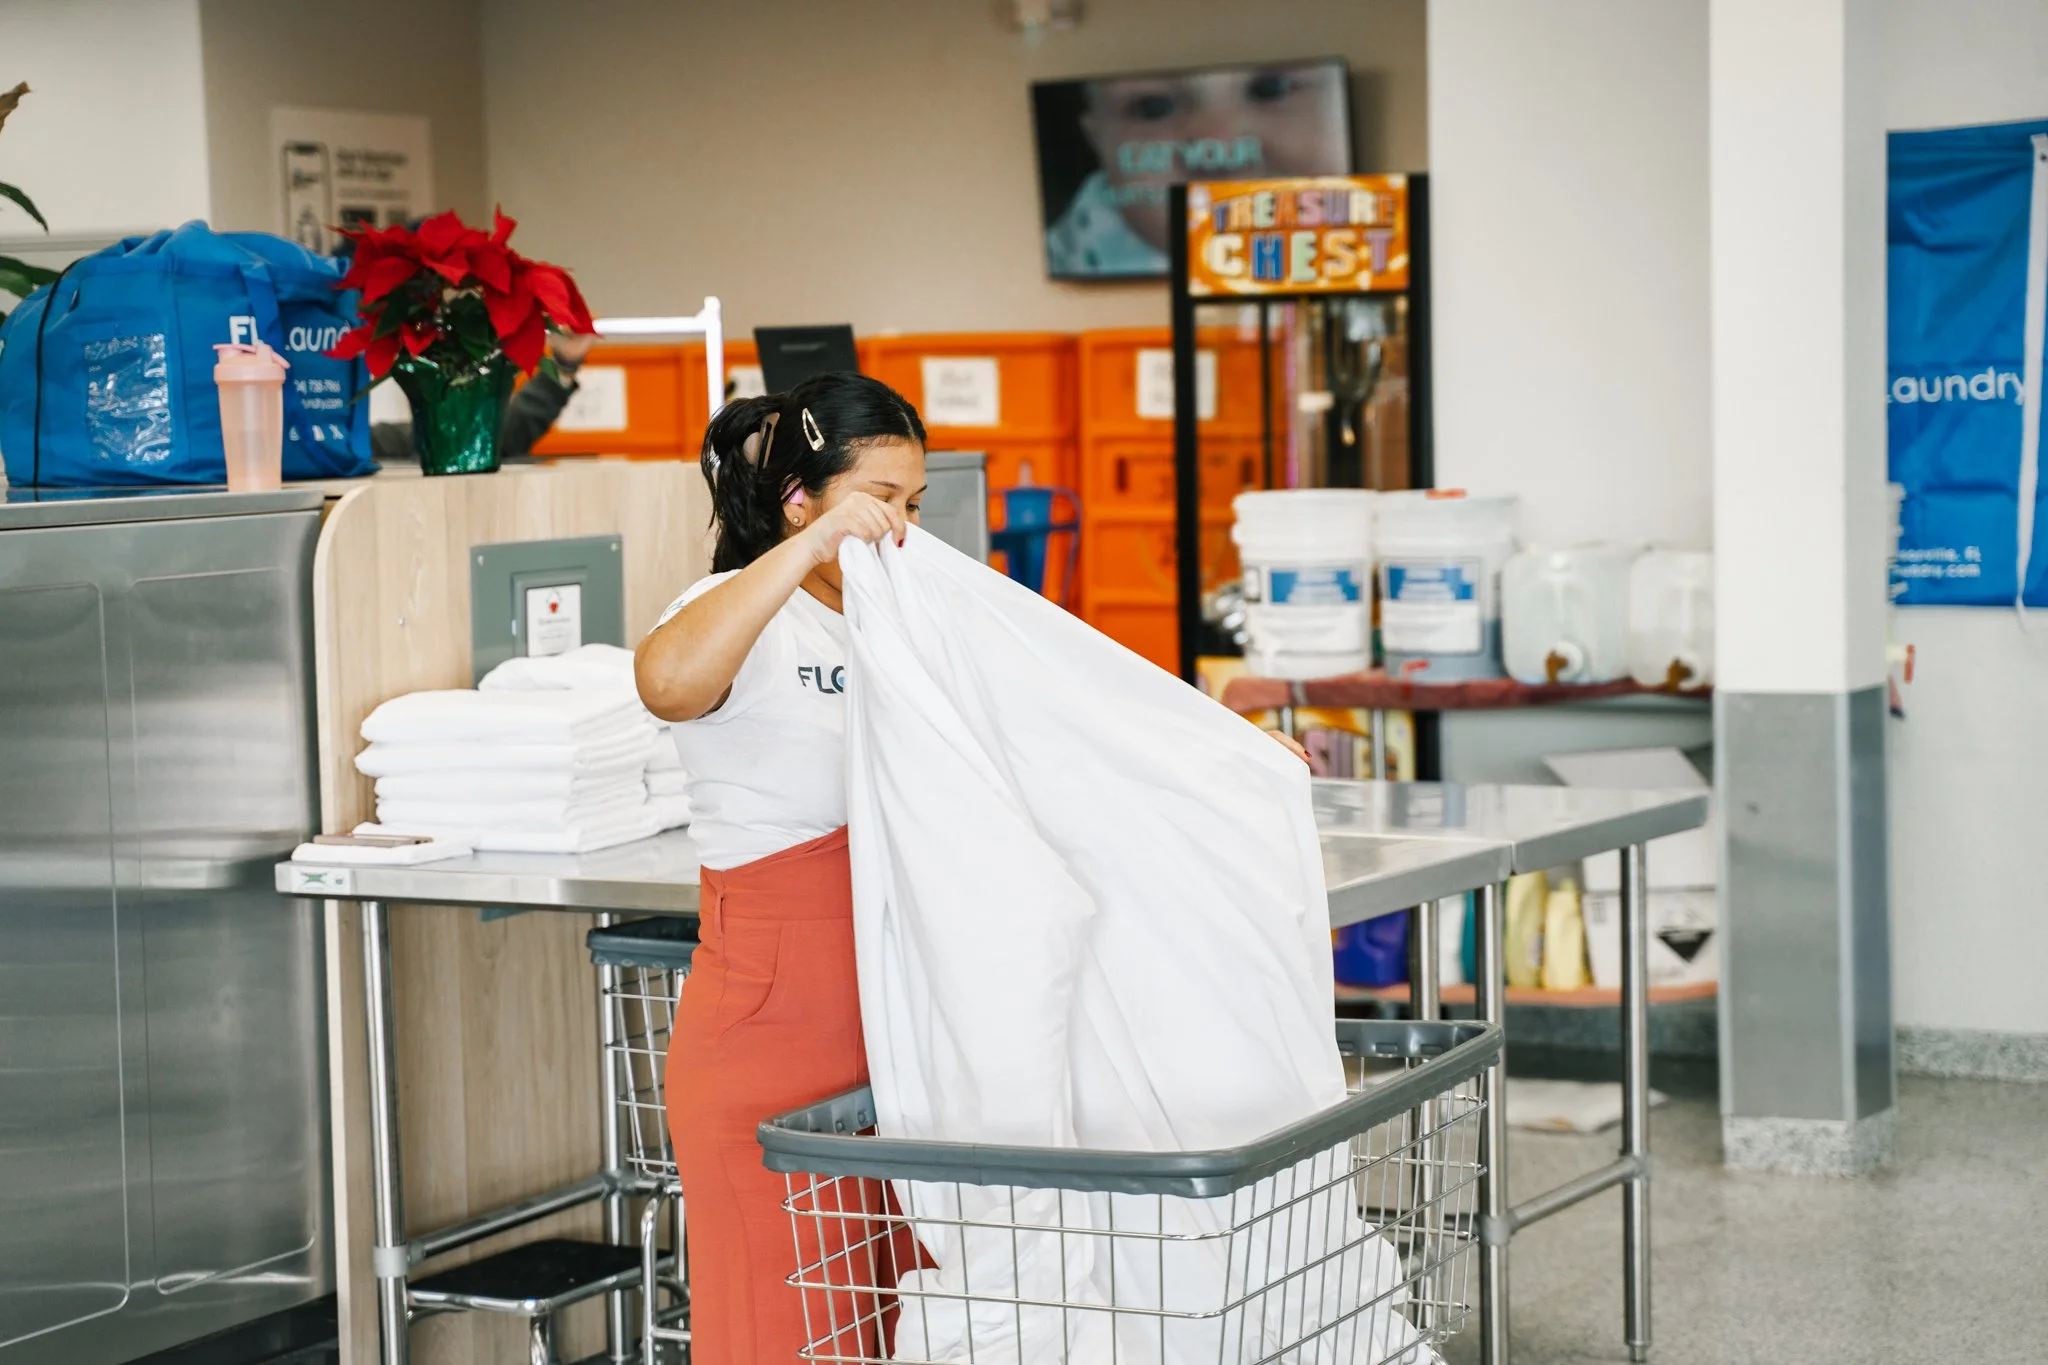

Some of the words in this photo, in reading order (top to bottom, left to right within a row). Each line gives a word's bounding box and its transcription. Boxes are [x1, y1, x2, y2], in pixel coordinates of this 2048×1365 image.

[1212, 189, 1396, 233] TREASURE
[1208, 228, 1394, 283] CHEST
[229, 315, 260, 346] FL
[285, 320, 352, 352] aun
[1886, 366, 2026, 406] aundry
